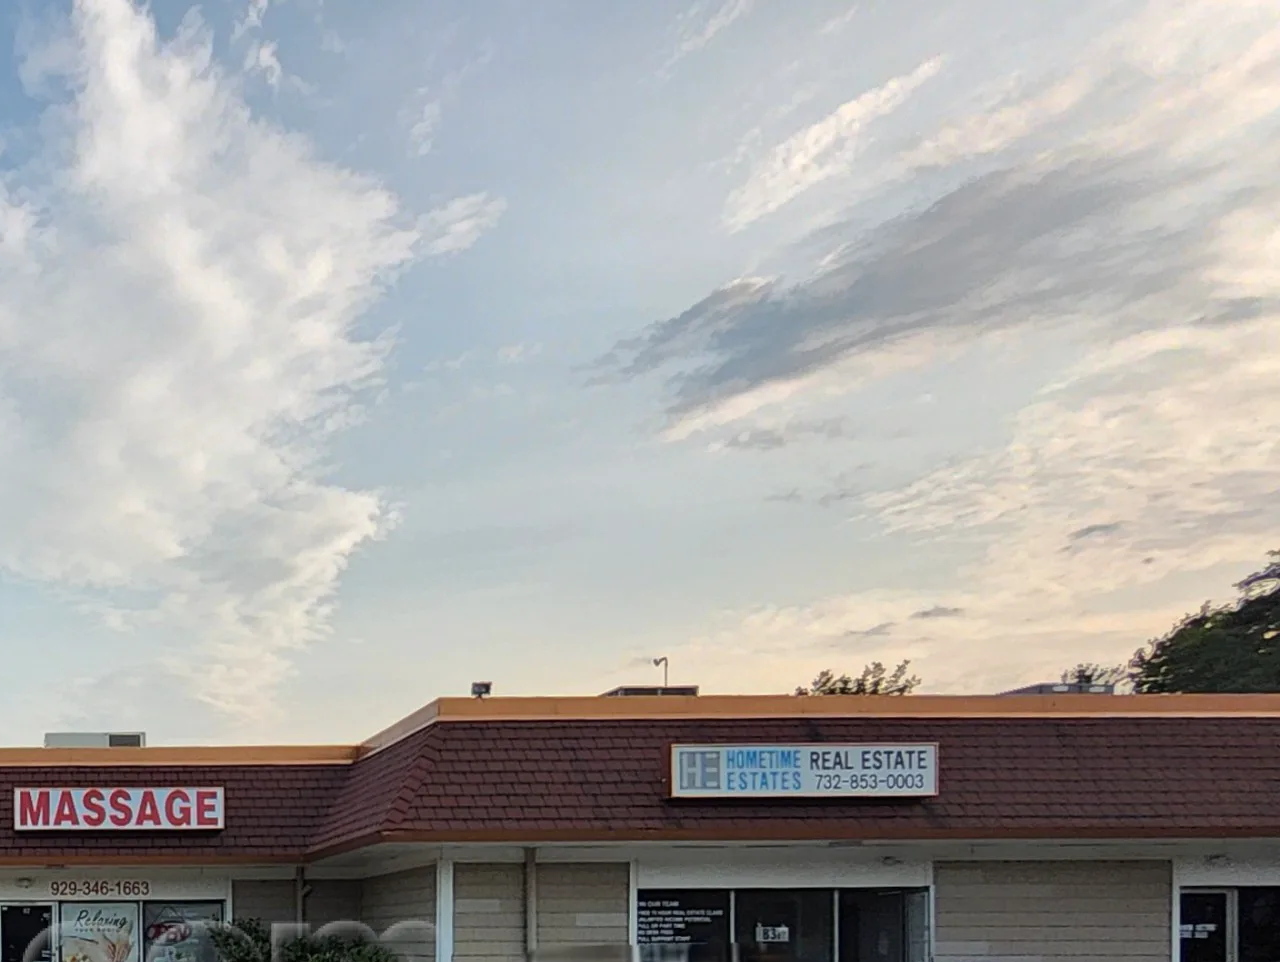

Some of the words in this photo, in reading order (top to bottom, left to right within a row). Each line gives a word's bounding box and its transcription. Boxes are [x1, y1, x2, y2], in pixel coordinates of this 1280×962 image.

[726, 750, 802, 769] HOMETIME
[810, 751, 854, 770] REAL
[861, 750, 927, 770] ESTATE
[727, 771, 802, 791] ESTATES
[815, 774, 924, 789] 732-853-0003
[19, 789, 219, 827] MASSAGE
[50, 881, 151, 896] 929-346-1663
[75, 909, 128, 929] Relaxing
